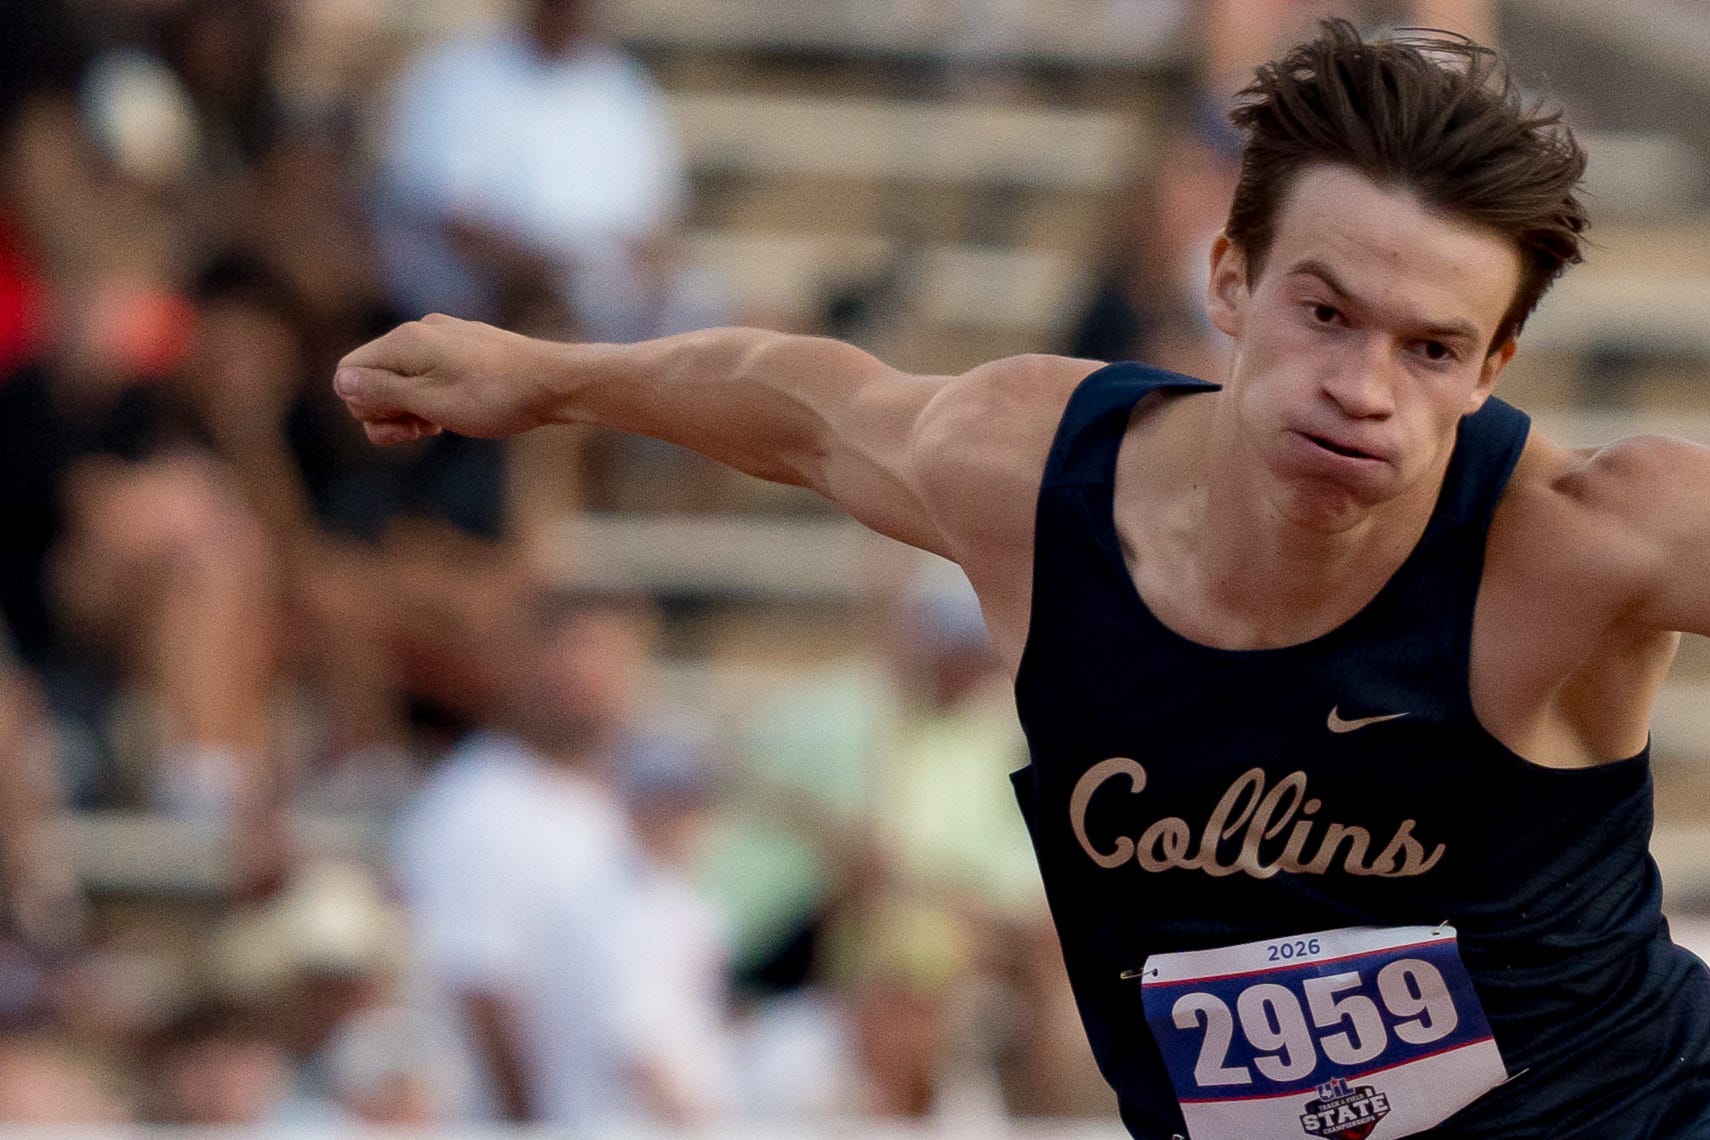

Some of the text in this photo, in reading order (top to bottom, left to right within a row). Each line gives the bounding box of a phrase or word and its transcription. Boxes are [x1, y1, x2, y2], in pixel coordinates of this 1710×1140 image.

[1069, 757, 1446, 879] Collins
[1267, 938, 1321, 961] 2026
[1171, 958, 1459, 1086] 2959
[1302, 1094, 1389, 1131] STATE
